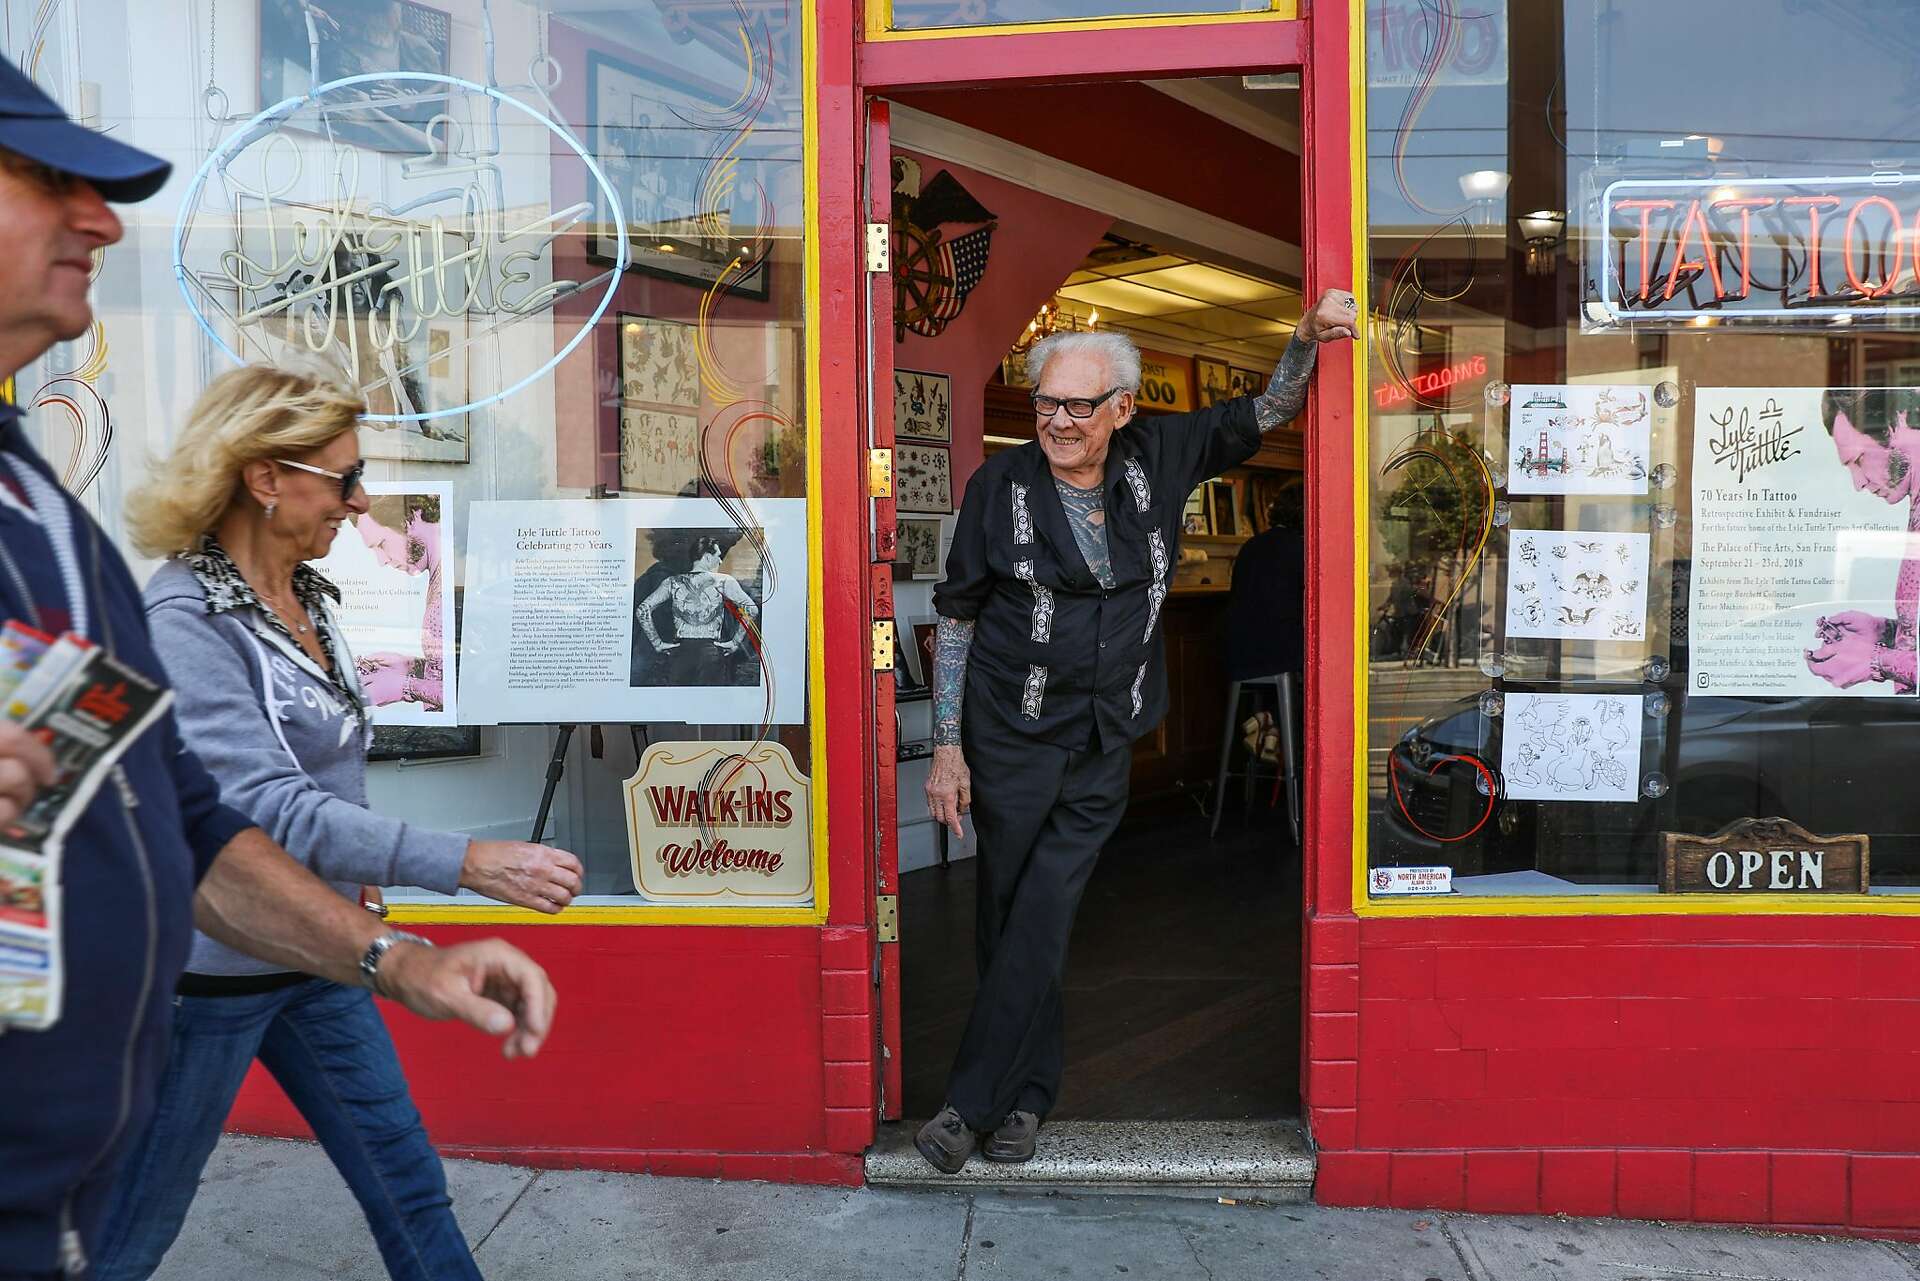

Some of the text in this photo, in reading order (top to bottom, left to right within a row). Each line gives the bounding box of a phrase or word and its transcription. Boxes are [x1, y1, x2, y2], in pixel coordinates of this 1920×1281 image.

[1614, 196, 1920, 300] TATTO
[1709, 406, 1757, 455] Lyle
[1714, 420, 1804, 484] Tuttle
[1701, 489, 1798, 501] 70 Years In Tattoo
[1701, 508, 1842, 521] Retrospective Exhibit & Fundraiser
[518, 528, 600, 540] Lyle Tuttle Tattoo
[1788, 524, 1804, 534] Lyle
[516, 540, 613, 552] Celebrating 70 Years
[1702, 543, 1715, 552] The
[1717, 543, 1742, 552] Palace
[1744, 543, 1752, 552] of
[1754, 543, 1772, 552] Fine
[1774, 543, 1794, 554] Arts,
[1796, 543, 1811, 552] San
[1700, 558, 1742, 570] September
[1744, 558, 1753, 568] 21
[1762, 558, 1782, 569] 23rd,
[1784, 558, 1804, 568] 2018
[1744, 577, 1754, 585] The
[1756, 577, 1769, 586] Lyle
[1771, 577, 1790, 585] Tuttle
[1791, 577, 1812, 585] Tattoo
[648, 785, 793, 826] WALK-INS
[661, 838, 785, 875] Welcome
[1706, 851, 1825, 889] OPEN
